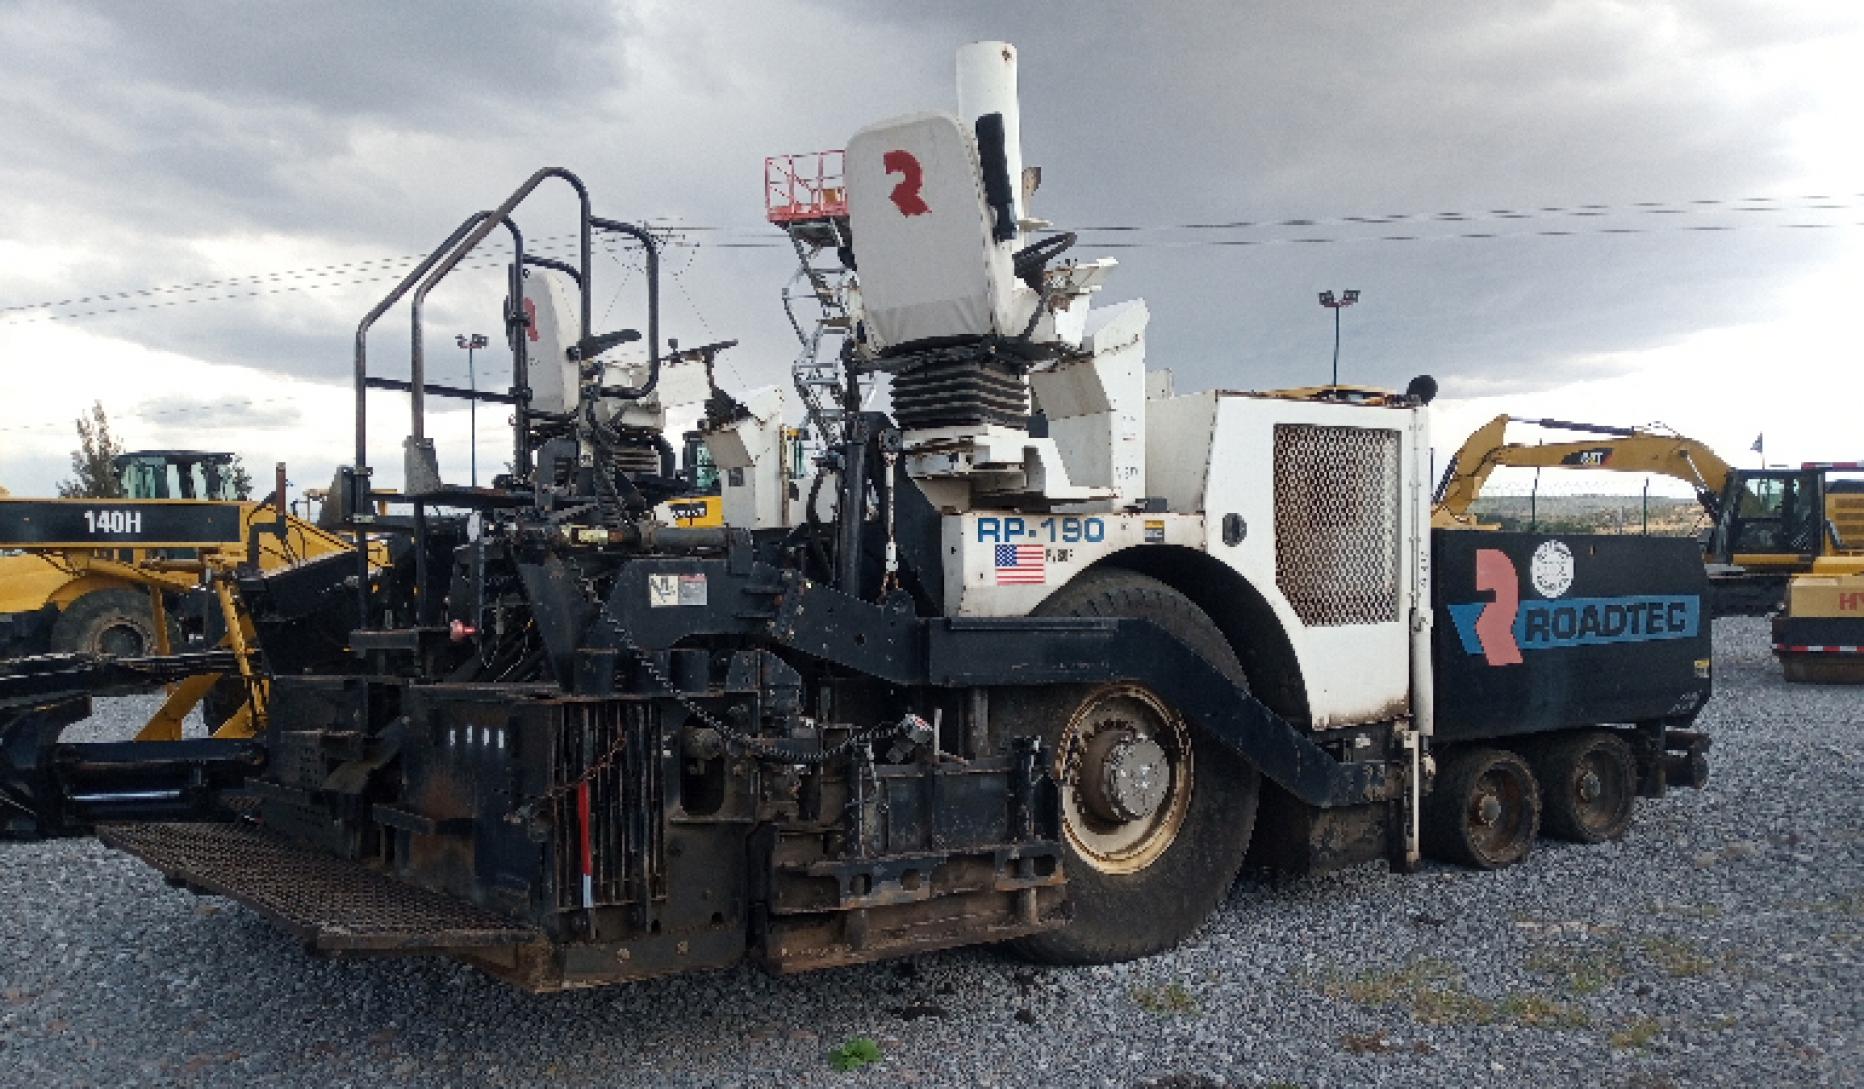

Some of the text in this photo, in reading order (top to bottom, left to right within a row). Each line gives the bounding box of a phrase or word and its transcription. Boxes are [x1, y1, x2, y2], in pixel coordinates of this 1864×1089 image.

[84, 510, 141, 533] 140H
[977, 517, 1104, 543] RP-190
[1524, 602, 1686, 642] ROADTEC
